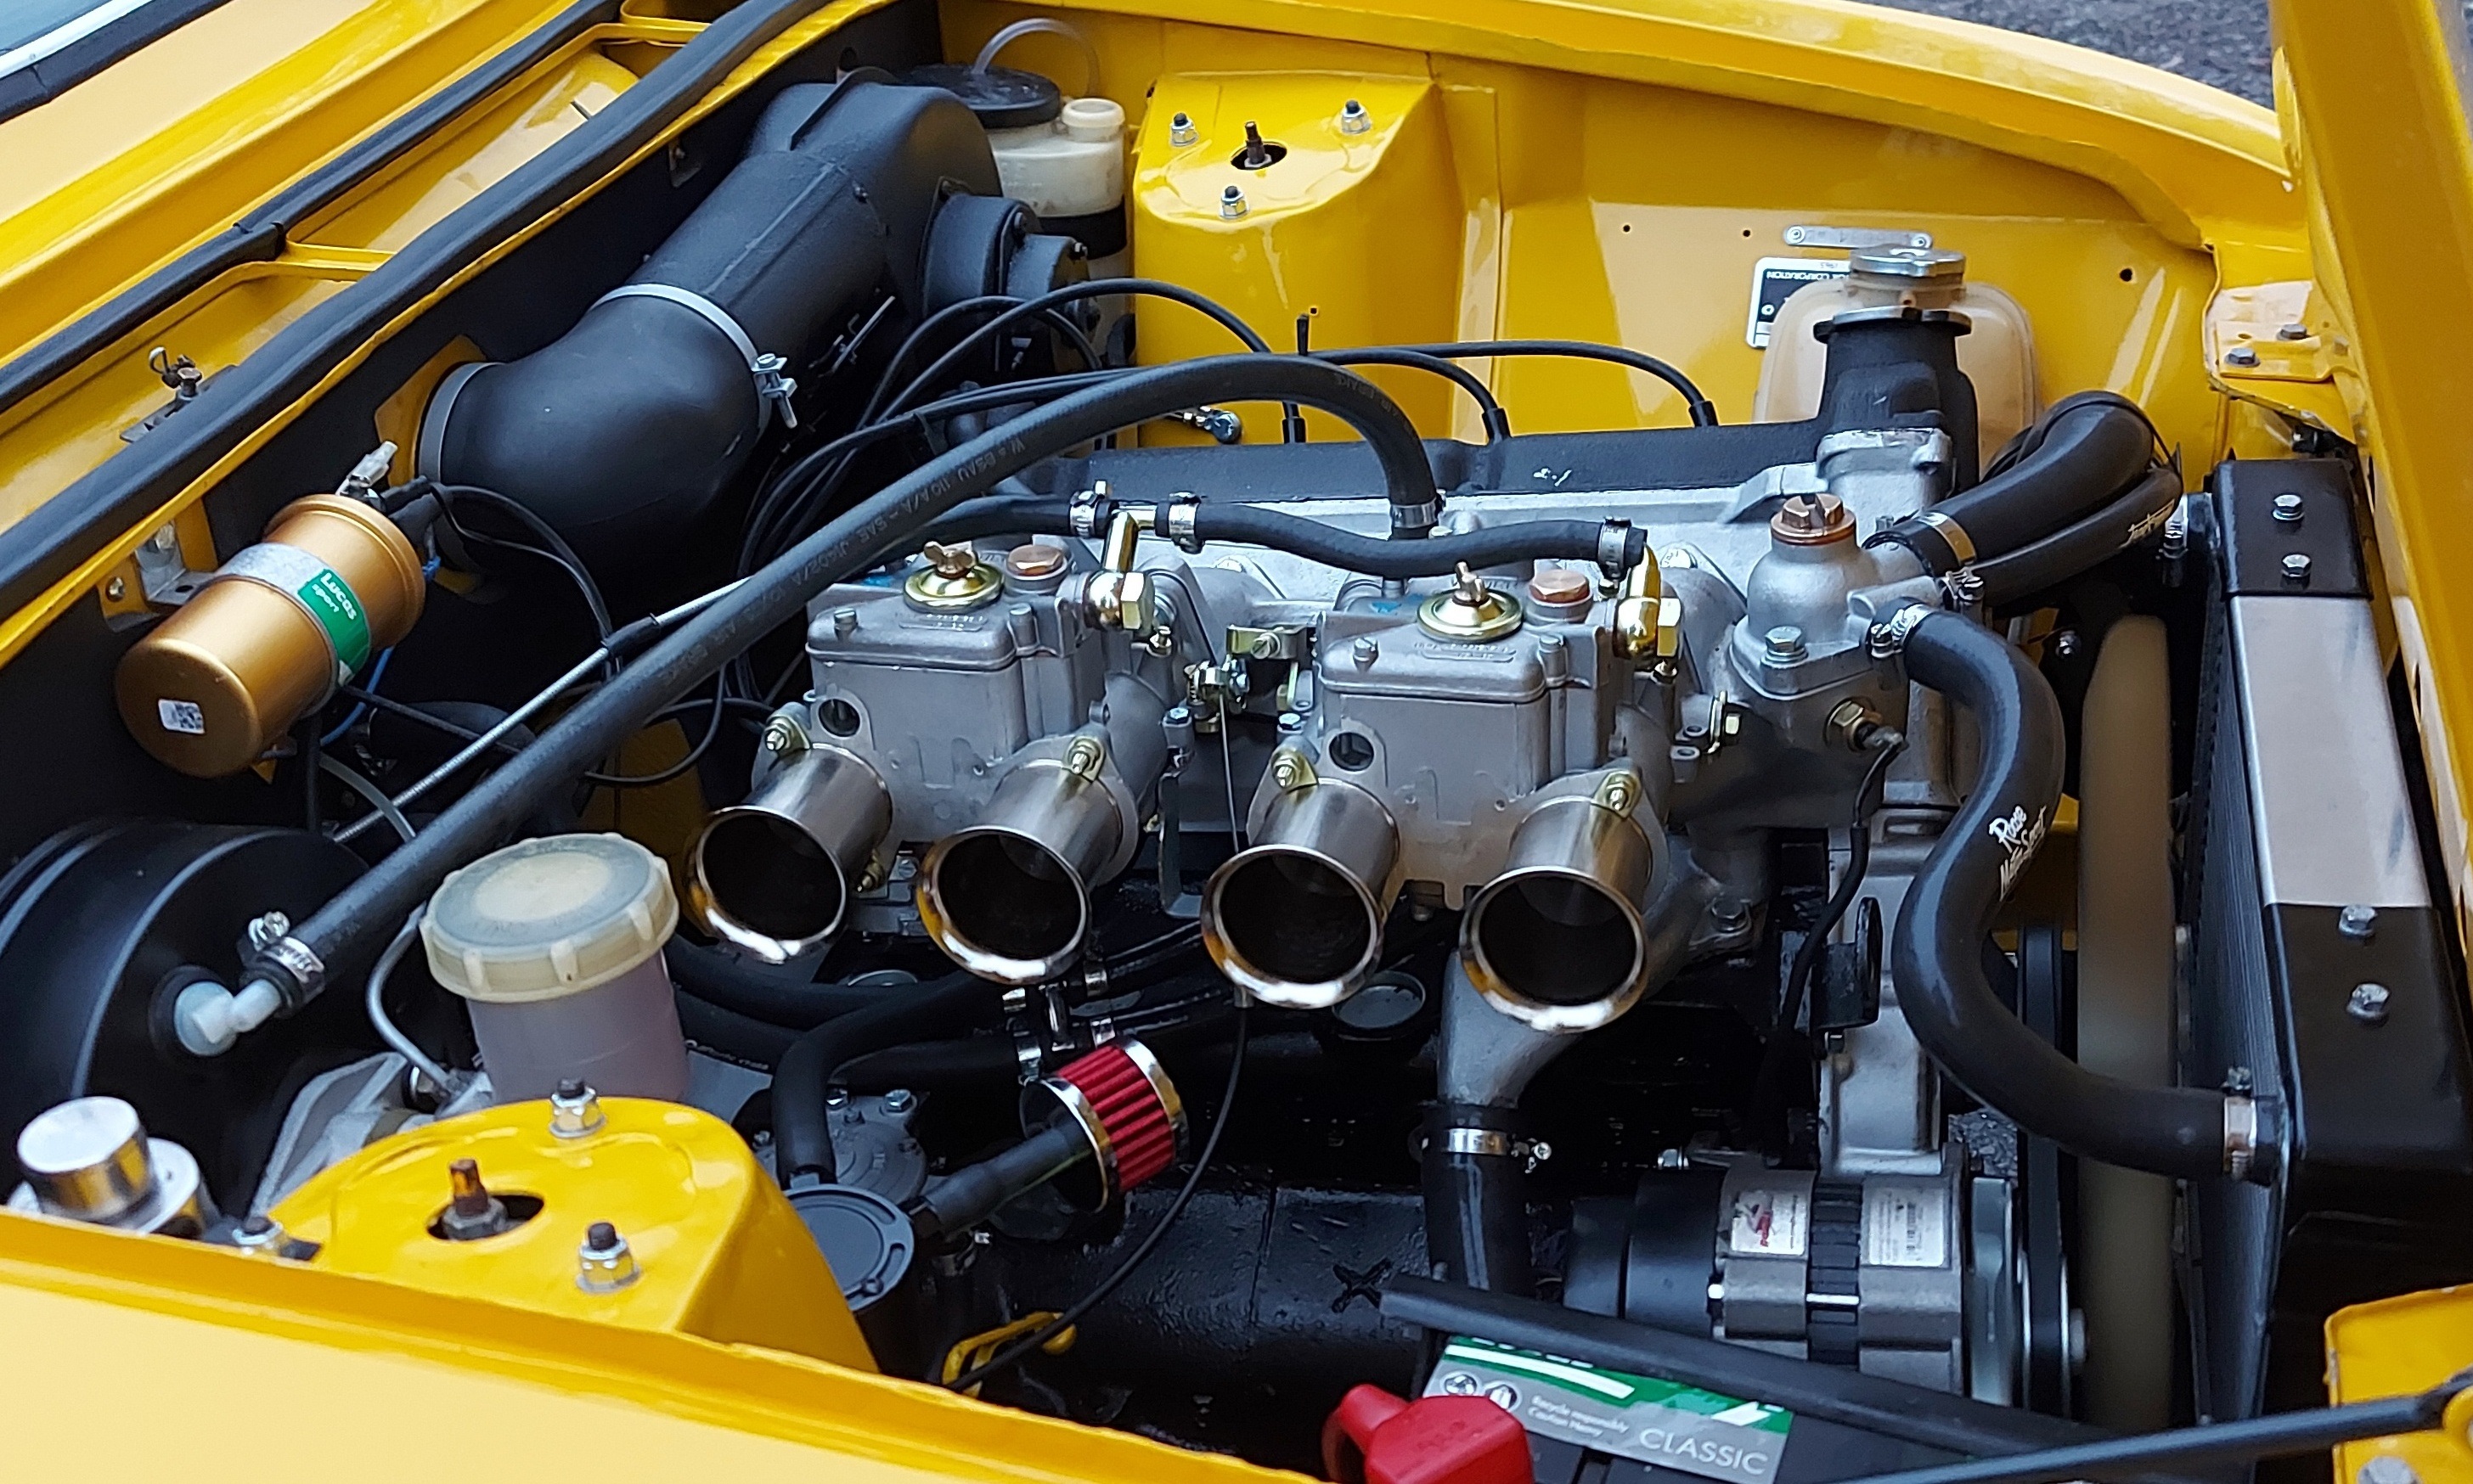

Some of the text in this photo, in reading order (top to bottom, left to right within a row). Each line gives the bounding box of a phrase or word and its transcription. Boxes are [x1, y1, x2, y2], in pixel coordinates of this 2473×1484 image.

[1766, 271, 1829, 280] CORPORATION
[855, 515, 888, 543] SAE
[312, 584, 340, 613] sport
[321, 572, 357, 620] Lucas
[1639, 1427, 1768, 1476] CLASSIC
